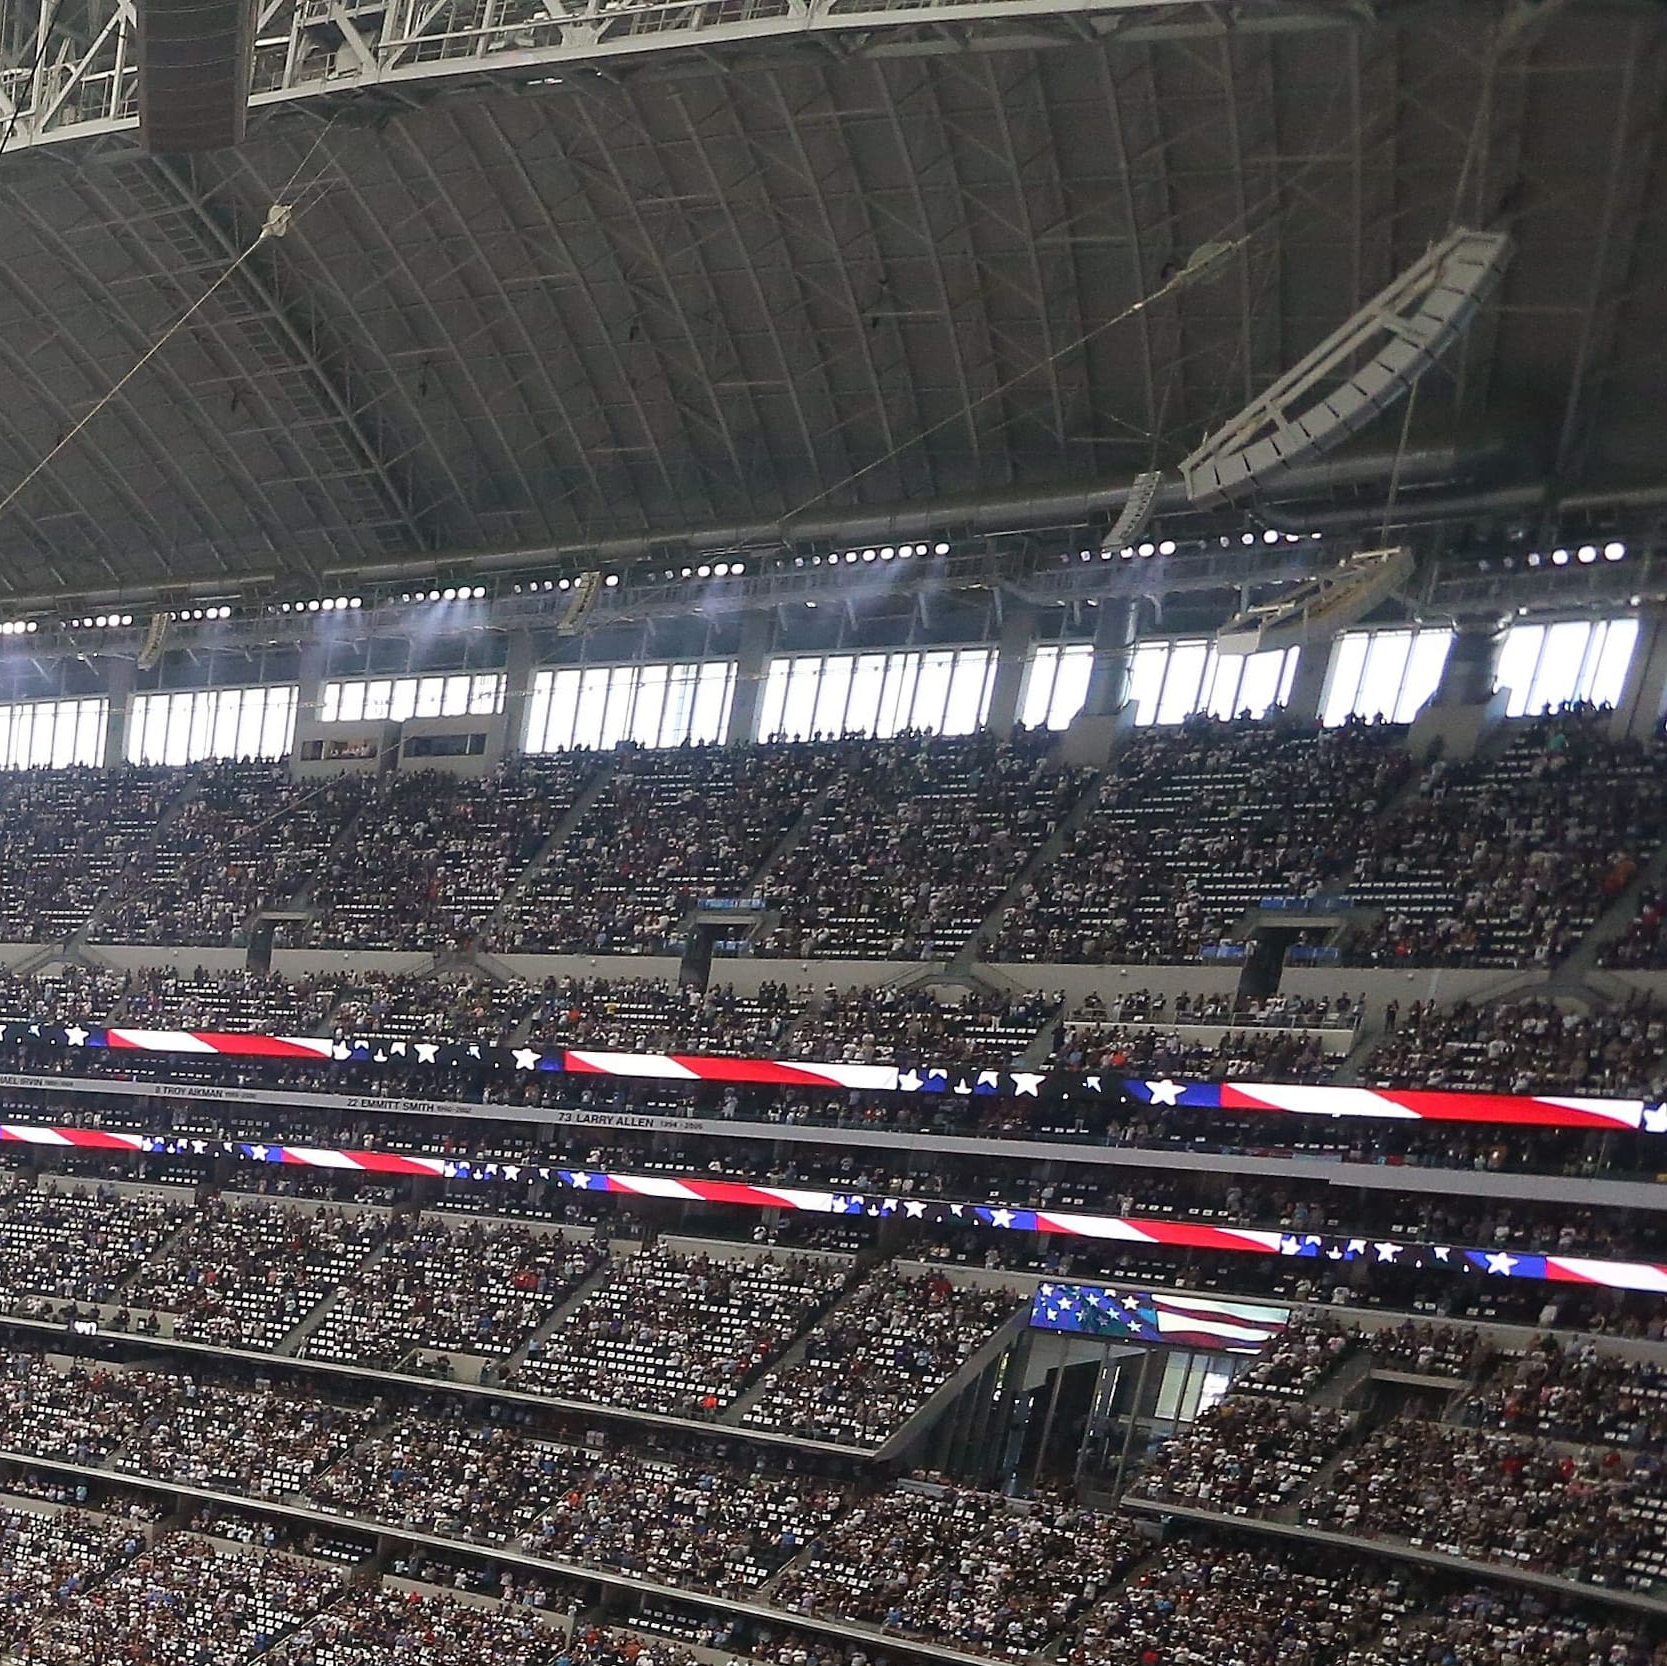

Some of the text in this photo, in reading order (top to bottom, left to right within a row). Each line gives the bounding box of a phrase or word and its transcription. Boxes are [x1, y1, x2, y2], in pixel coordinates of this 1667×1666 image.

[20, 1078, 44, 1087] IRVIN
[163, 1086, 186, 1096] TROY
[188, 1088, 224, 1099] AIKMAN
[347, 1098, 358, 1107] 22
[361, 1099, 400, 1110] EMMITT
[403, 1102, 435, 1112] SMITH
[558, 1112, 572, 1122] 73
[576, 1114, 613, 1126] LARRY
[616, 1117, 654, 1128] ALLEN
